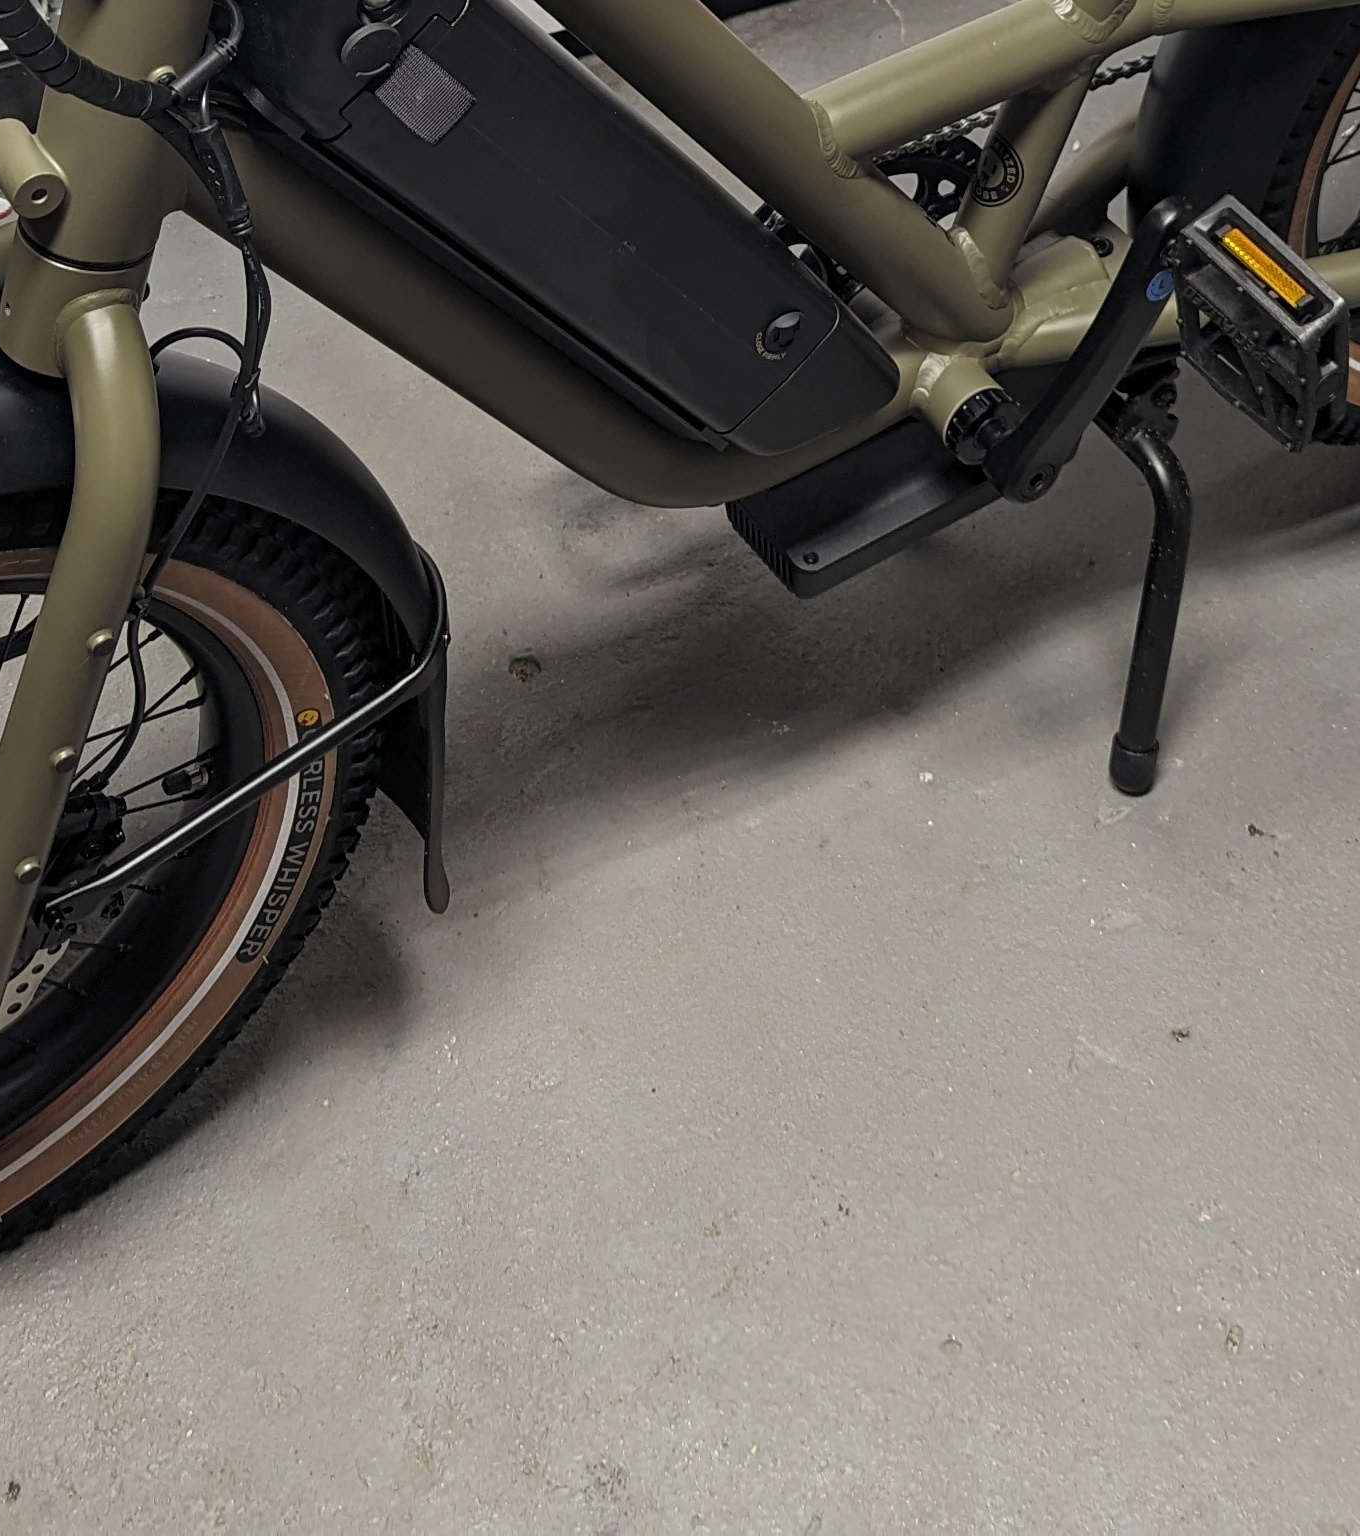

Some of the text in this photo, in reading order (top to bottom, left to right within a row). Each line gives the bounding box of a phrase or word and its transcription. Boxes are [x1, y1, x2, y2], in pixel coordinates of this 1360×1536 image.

[1181, 285, 1277, 370] SPECIALIZED
[240, 728, 324, 958] RLESS WHISPER
